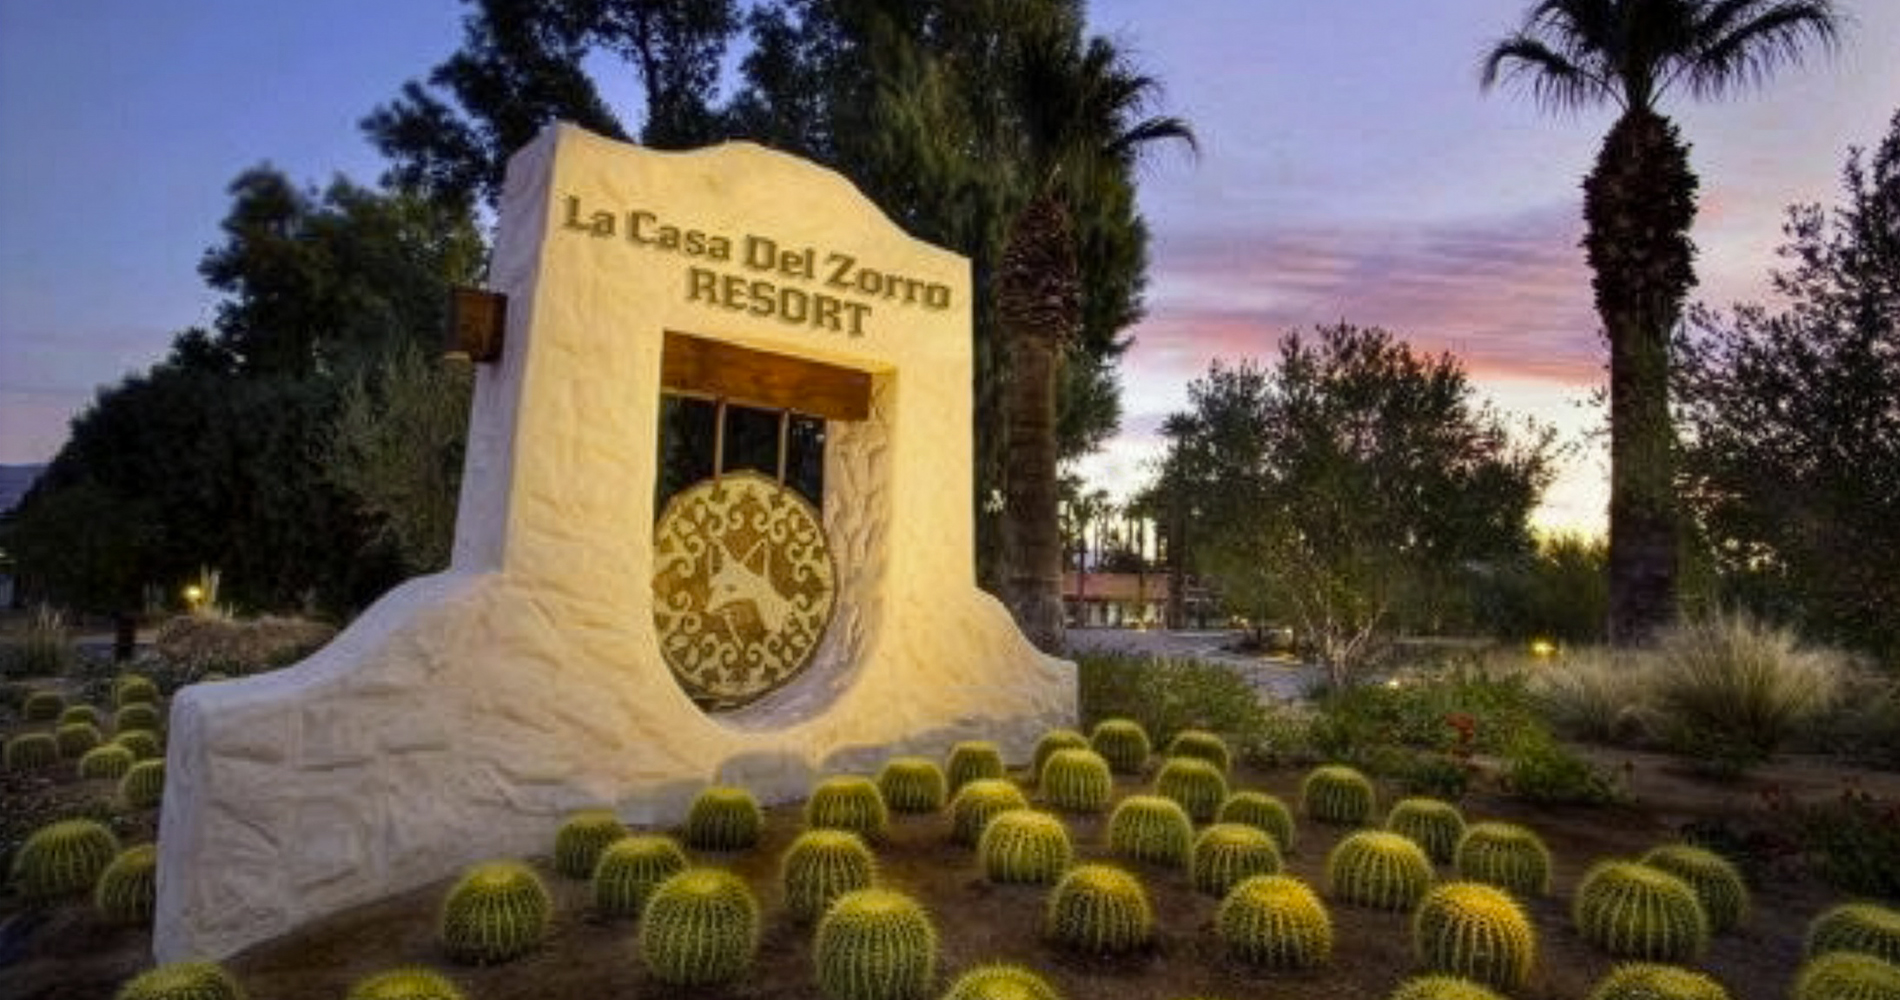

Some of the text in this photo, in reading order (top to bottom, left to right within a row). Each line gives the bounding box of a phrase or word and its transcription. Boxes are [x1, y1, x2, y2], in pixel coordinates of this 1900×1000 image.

[563, 195, 952, 310] La Casa Del Zorro
[687, 267, 873, 337] RESORT
